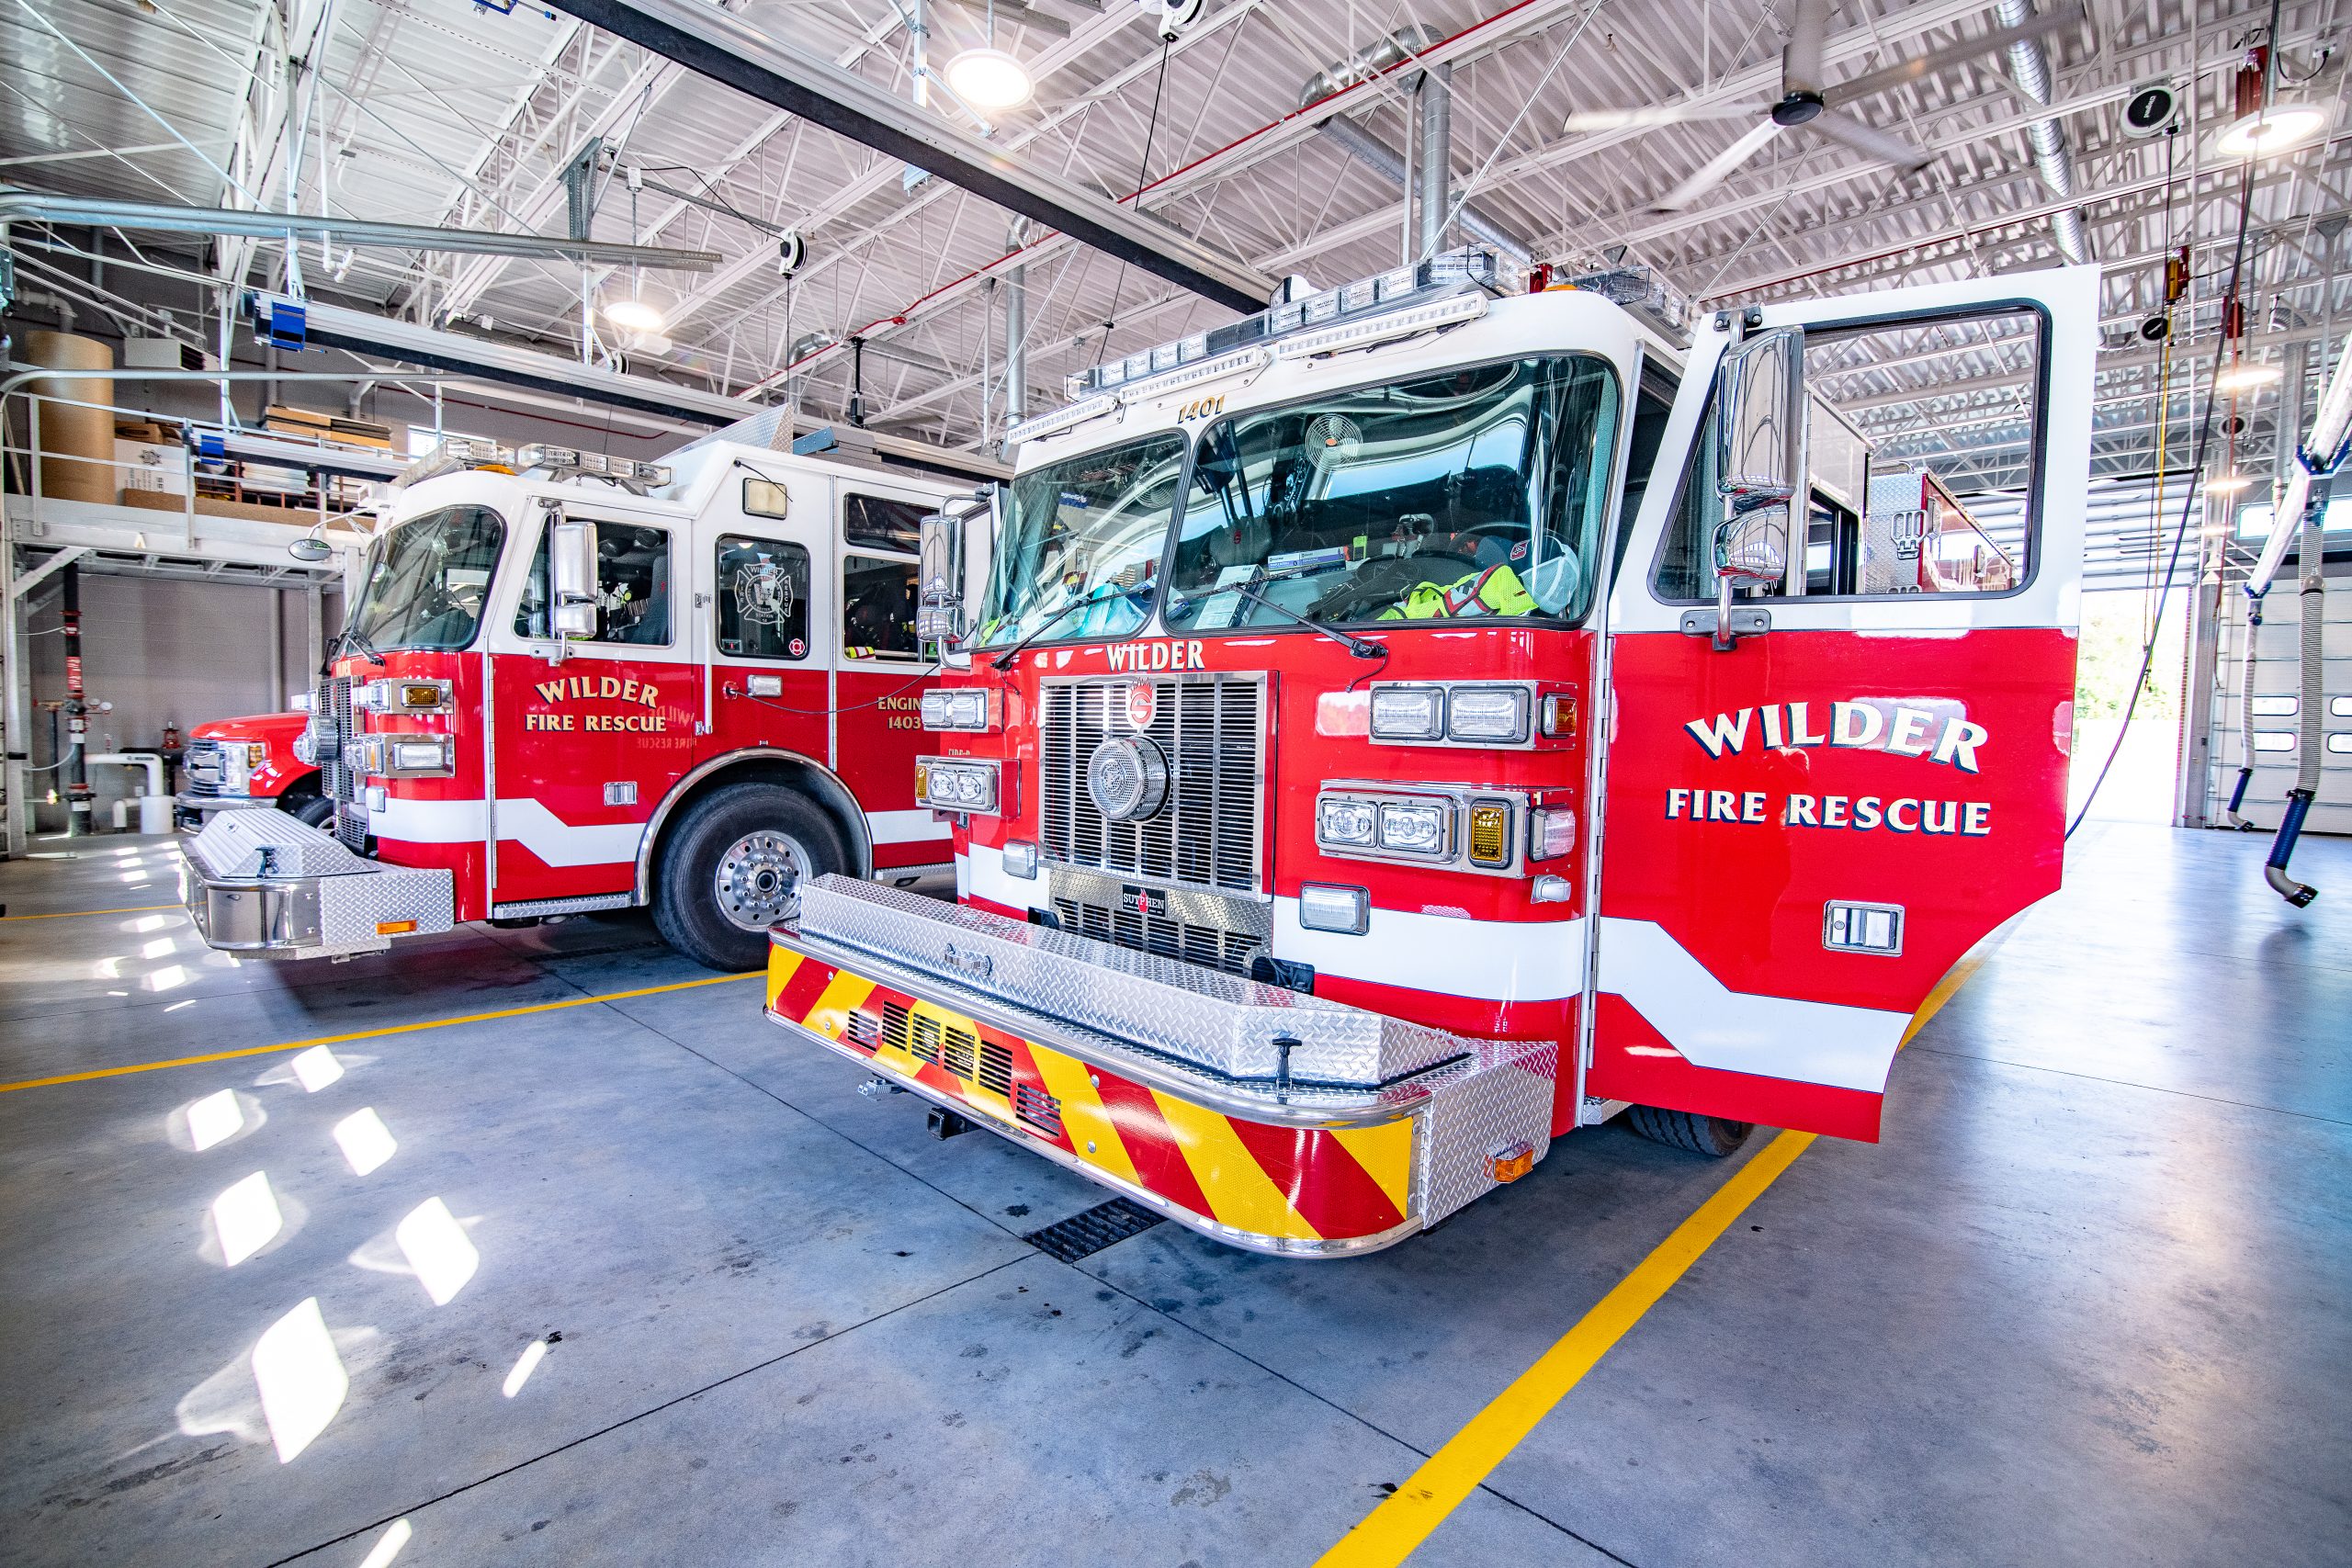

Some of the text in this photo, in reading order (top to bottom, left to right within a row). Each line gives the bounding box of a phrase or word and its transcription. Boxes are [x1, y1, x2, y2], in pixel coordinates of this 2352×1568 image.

[1177, 394, 1225, 424] 1401
[1105, 640, 1205, 672] WILDER
[535, 676, 659, 709] WILDER
[877, 696, 922, 712] ENGIN
[526, 714, 667, 733] FIRE RESCUE
[888, 716, 922, 730] 1403
[1684, 701, 1988, 774] WILDER
[1665, 787, 1992, 837] FIRE RESCUE
[1123, 892, 1165, 909] SUTPHEN
